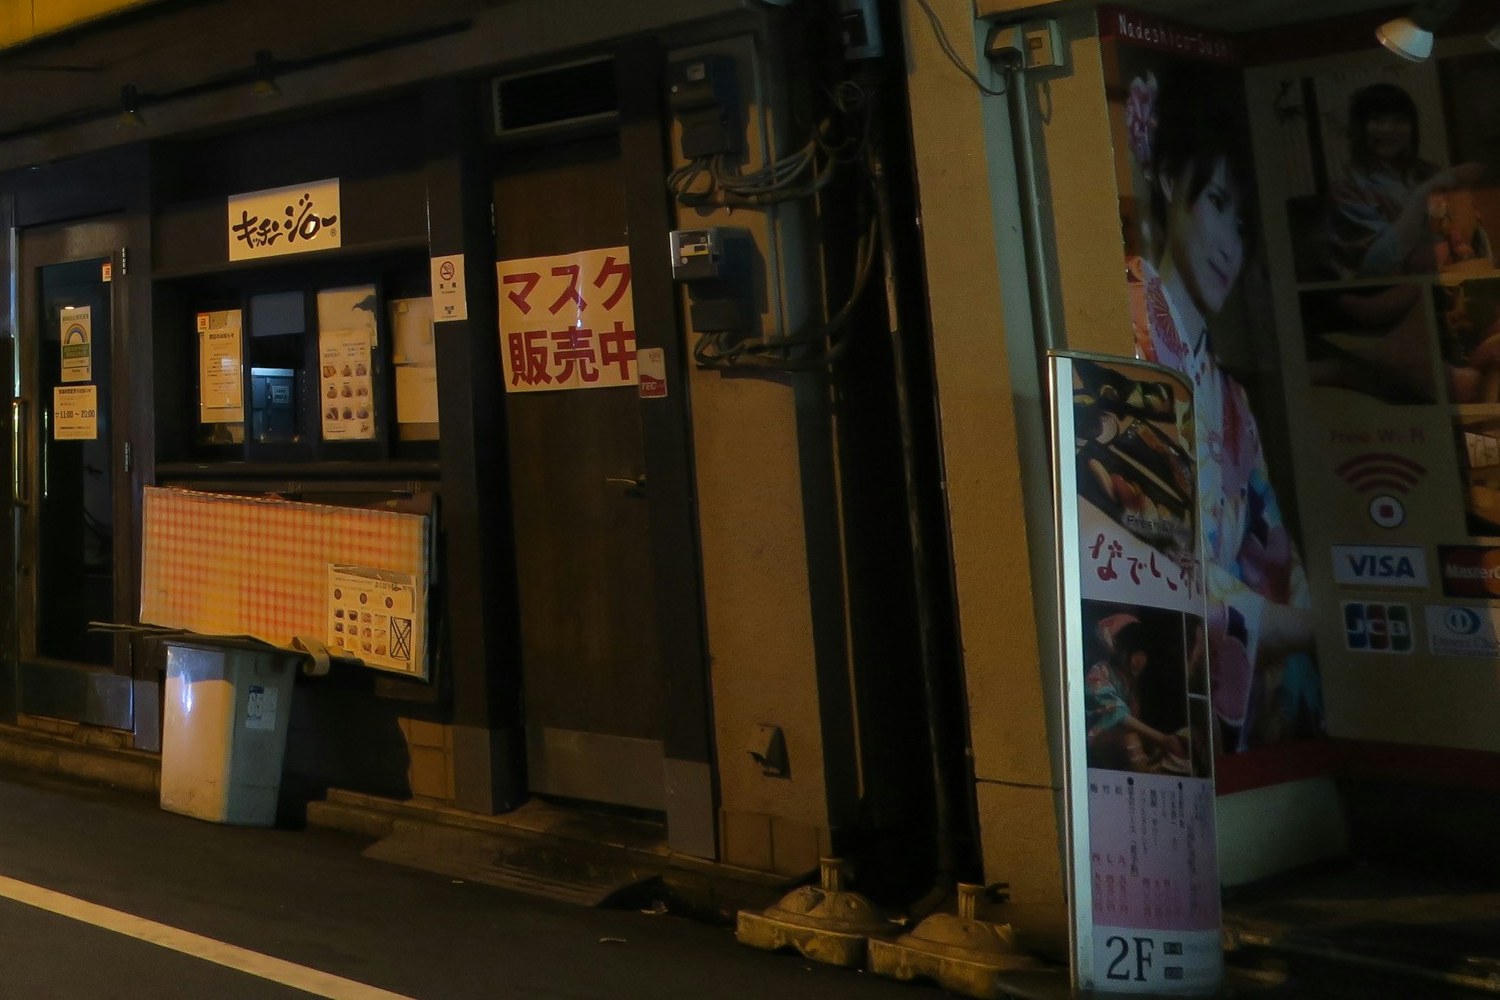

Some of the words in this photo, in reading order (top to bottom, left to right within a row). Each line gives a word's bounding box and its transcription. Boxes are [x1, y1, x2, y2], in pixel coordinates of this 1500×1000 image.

[502, 256, 633, 314] マスク
[509, 325, 638, 387] 販売中
[1347, 555, 1415, 578] VISA
[1346, 617, 1408, 636] JCB
[1106, 936, 1155, 981] 2F
